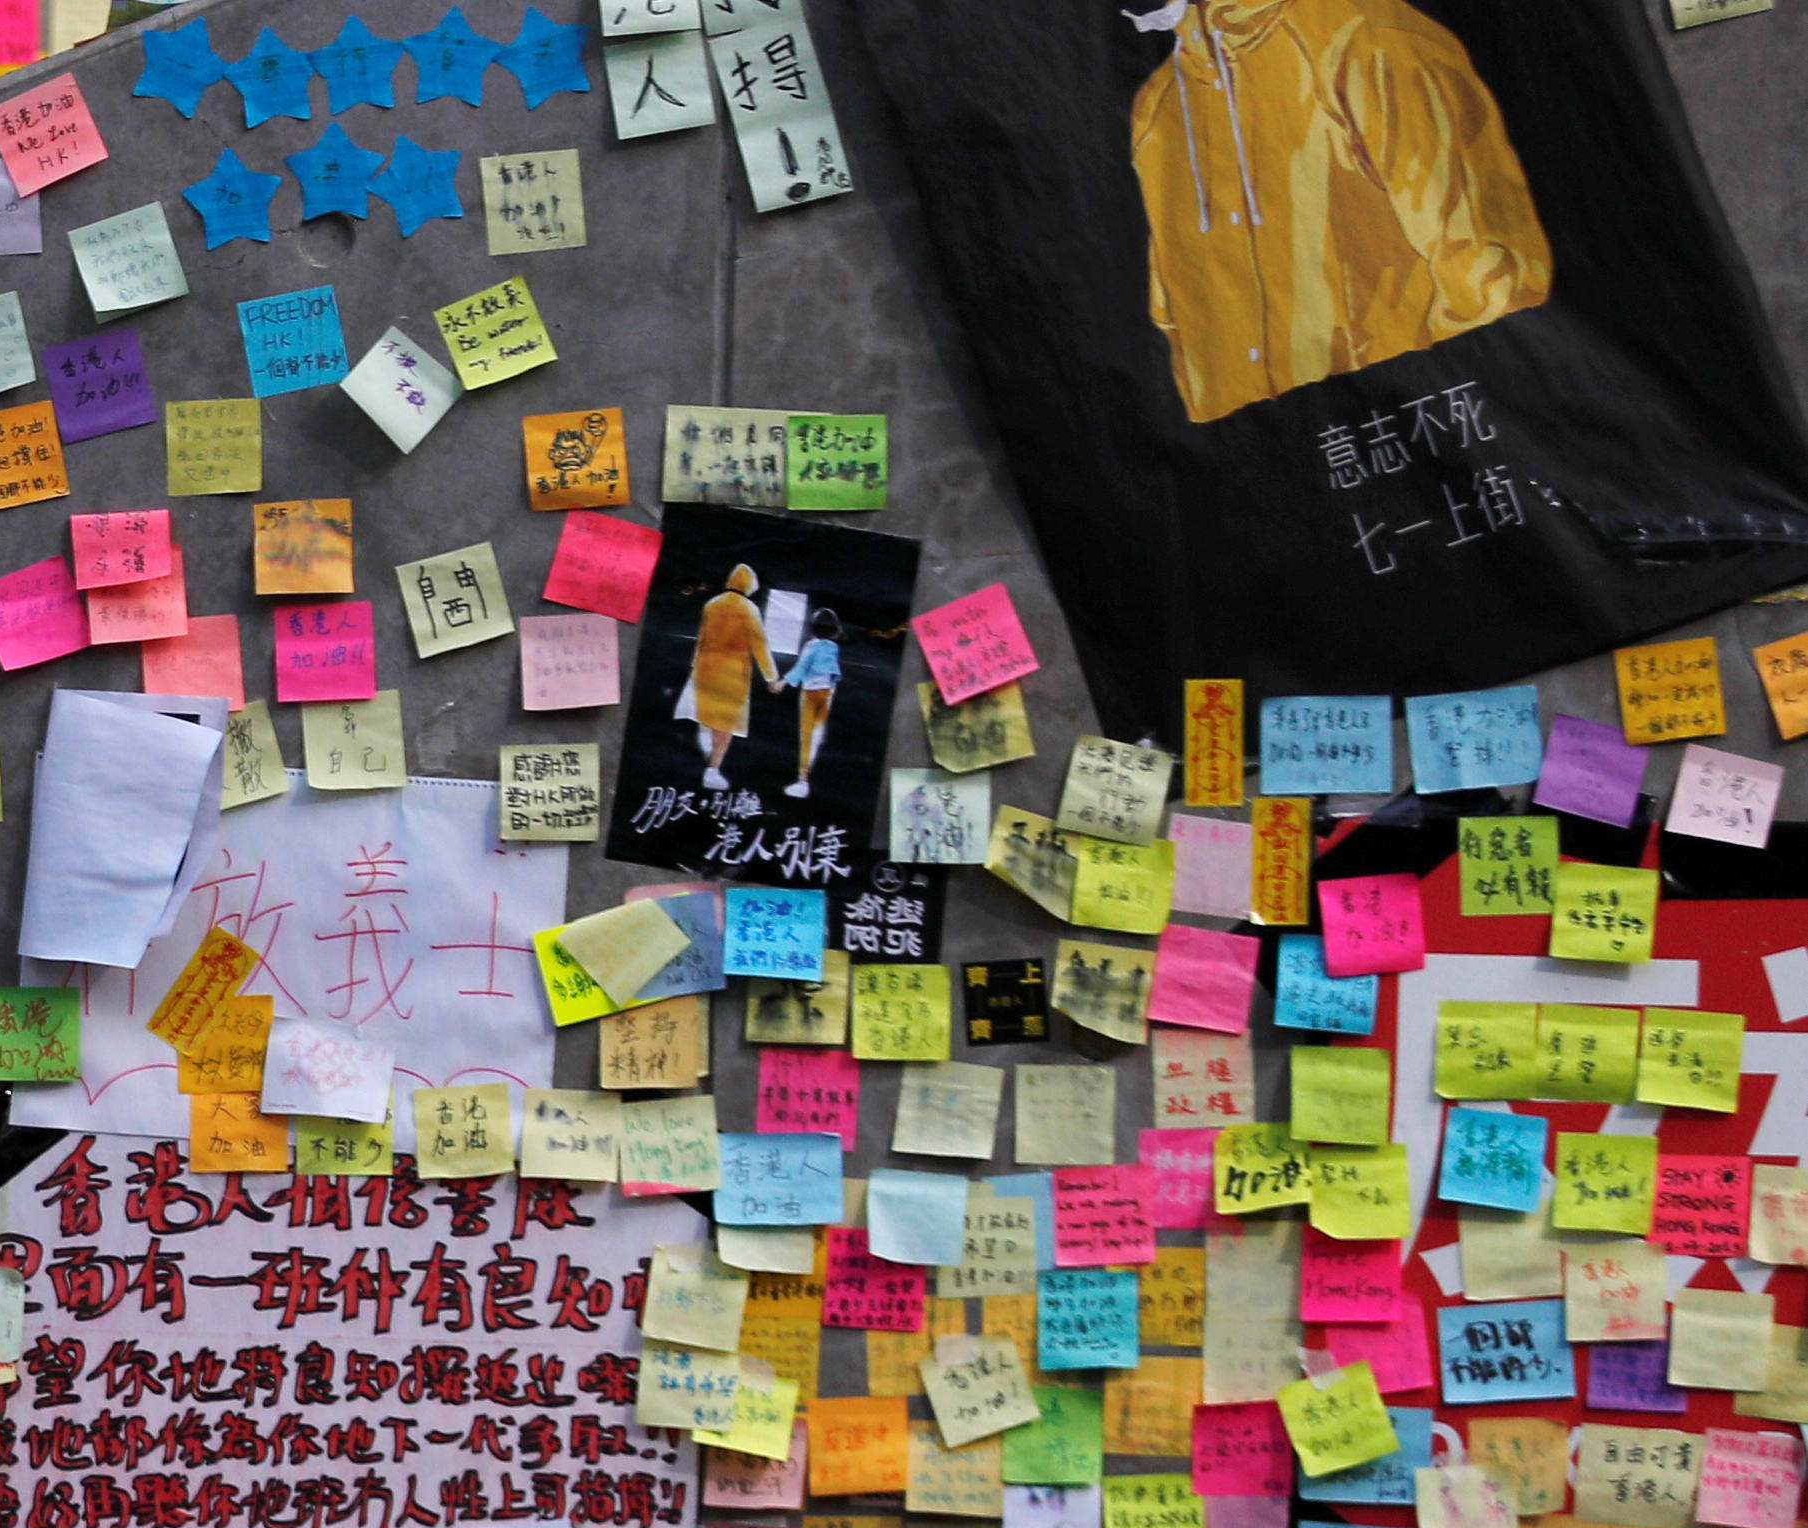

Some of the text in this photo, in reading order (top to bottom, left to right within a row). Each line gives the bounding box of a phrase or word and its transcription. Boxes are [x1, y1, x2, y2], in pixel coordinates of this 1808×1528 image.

[1319, 379, 1499, 491] 意志不死
[1350, 465, 1528, 576] 七一上街
